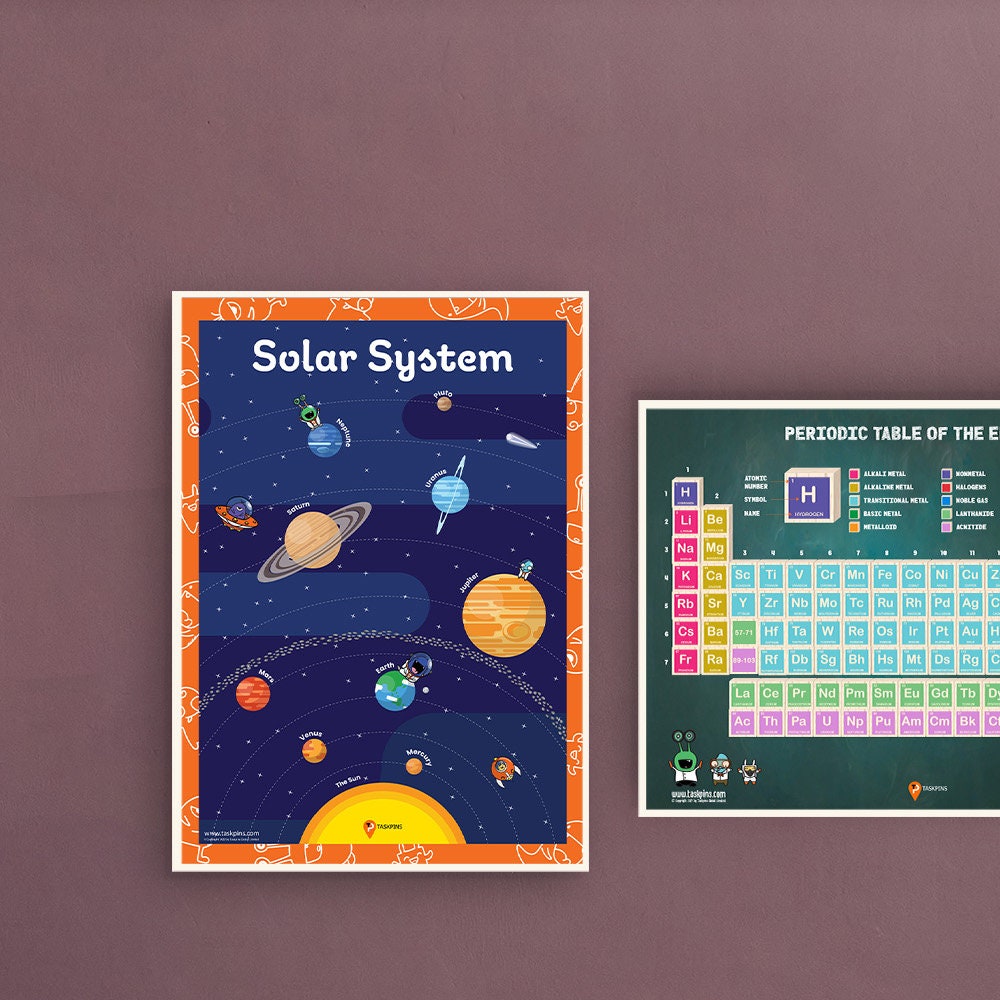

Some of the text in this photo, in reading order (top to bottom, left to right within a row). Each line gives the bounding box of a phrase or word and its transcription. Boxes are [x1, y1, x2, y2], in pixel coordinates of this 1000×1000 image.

[253, 339, 513, 382] Solar System
[433, 389, 453, 398] Pluto
[336, 418, 351, 448] Neptune
[785, 426, 868, 440] PERIODIC
[873, 426, 921, 440] TABLE
[927, 426, 948, 440] OF
[953, 426, 984, 440] THE
[425, 469, 447, 488] Uranus
[682, 487, 689, 497] H
[802, 486, 816, 503] H
[287, 501, 310, 515] Saturn
[681, 515, 691, 525] Li
[707, 515, 723, 525] Be
[677, 543, 694, 554] Na
[706, 543, 723, 554] Mg
[682, 571, 690, 580] K
[706, 571, 723, 581] Ca
[735, 570, 750, 579] Sc
[766, 570, 776, 579] Ti
[795, 570, 803, 579] V
[821, 570, 835, 579] Cr
[848, 570, 864, 579] Mn
[878, 570, 892, 579] Fe
[905, 570, 921, 579] Co
[936, 570, 948, 579] Ni
[962, 570, 978, 579] Cu
[459, 572, 479, 593] Jupiter
[375, 661, 395, 674] Earth
[258, 669, 274, 683] Mars
[736, 688, 750, 698] La
[763, 688, 779, 698] Ce
[793, 688, 806, 698] Pr
[819, 688, 835, 698] Nd
[846, 688, 864, 698] Pm
[875, 688, 893, 698] Sm
[904, 688, 920, 698] Eu
[932, 688, 948, 698] Gd
[960, 688, 976, 698] Tb
[299, 731, 323, 741] Venus
[406, 748, 432, 766] Mercury
[335, 775, 361, 788] The Sun
[672, 790, 726, 799] www.taskpins.com
